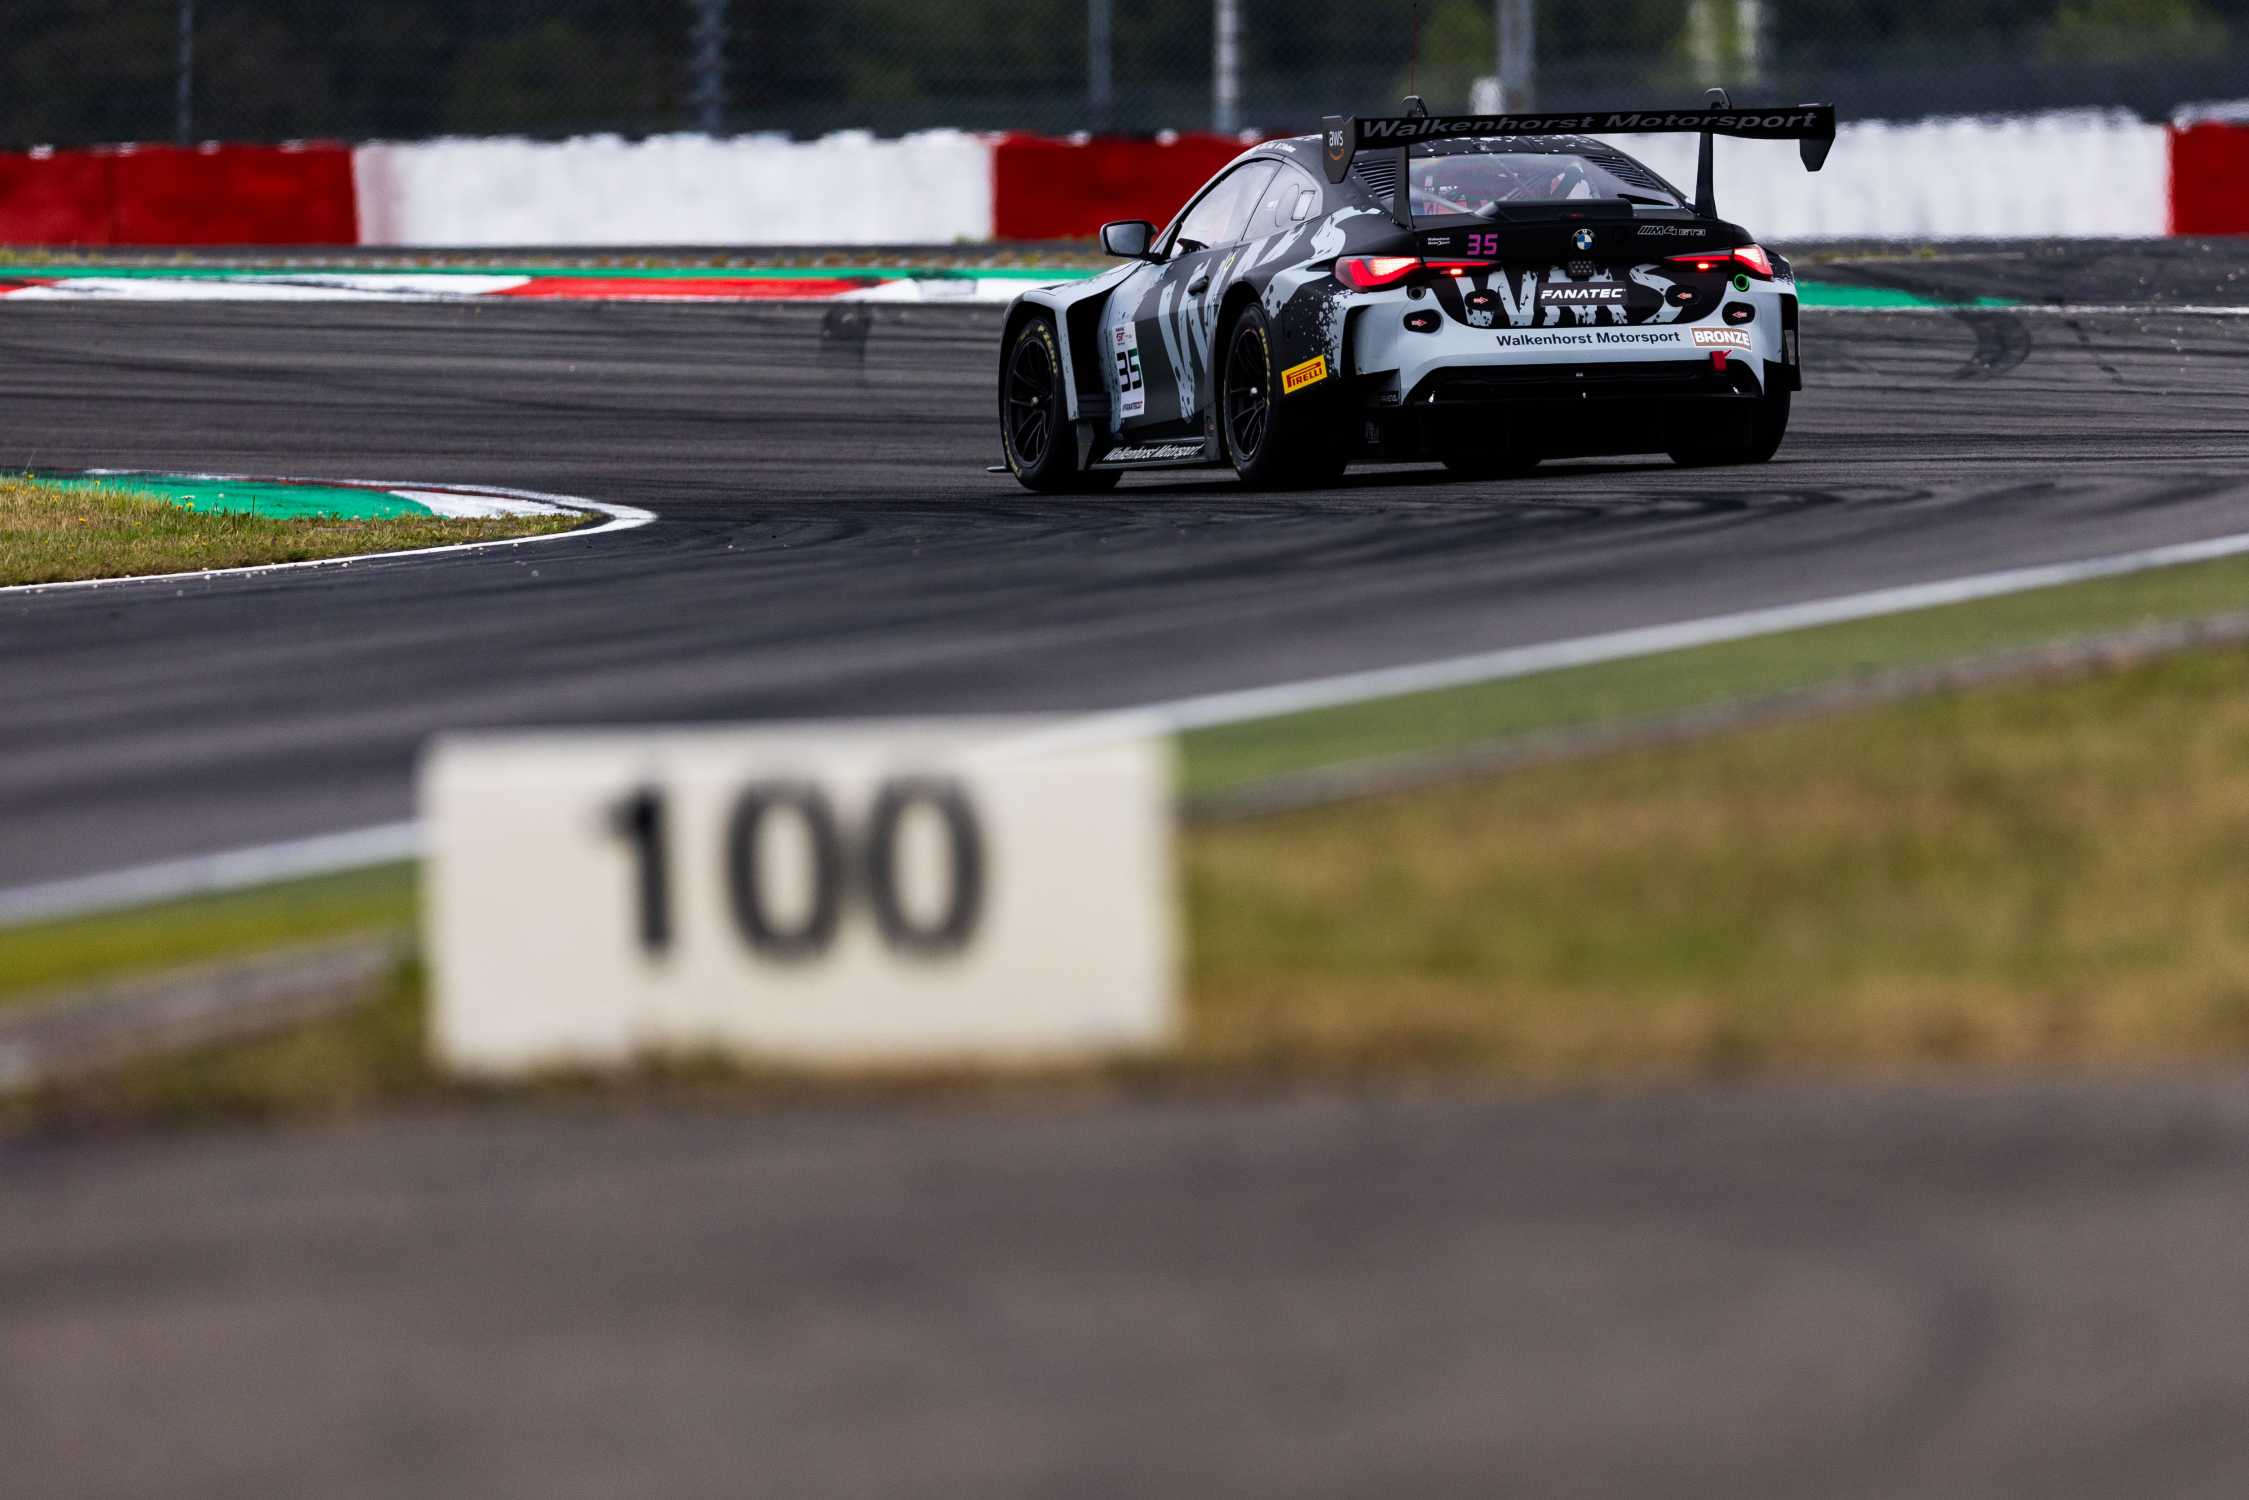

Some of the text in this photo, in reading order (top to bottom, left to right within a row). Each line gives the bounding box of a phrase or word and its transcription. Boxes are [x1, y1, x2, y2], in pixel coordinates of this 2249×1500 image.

[1363, 112, 1818, 138] Walkenhorst Motorsport
[1328, 130, 1344, 147] aws
[1467, 233, 1498, 255] 35
[1541, 288, 1623, 300] FANATEC
[1496, 331, 1680, 346] Walkenhorst Motorsport
[1694, 330, 1751, 346] BRONZE
[1117, 348, 1143, 392] 35
[1286, 361, 1323, 388] PIRELLI
[602, 779, 987, 961] 100
